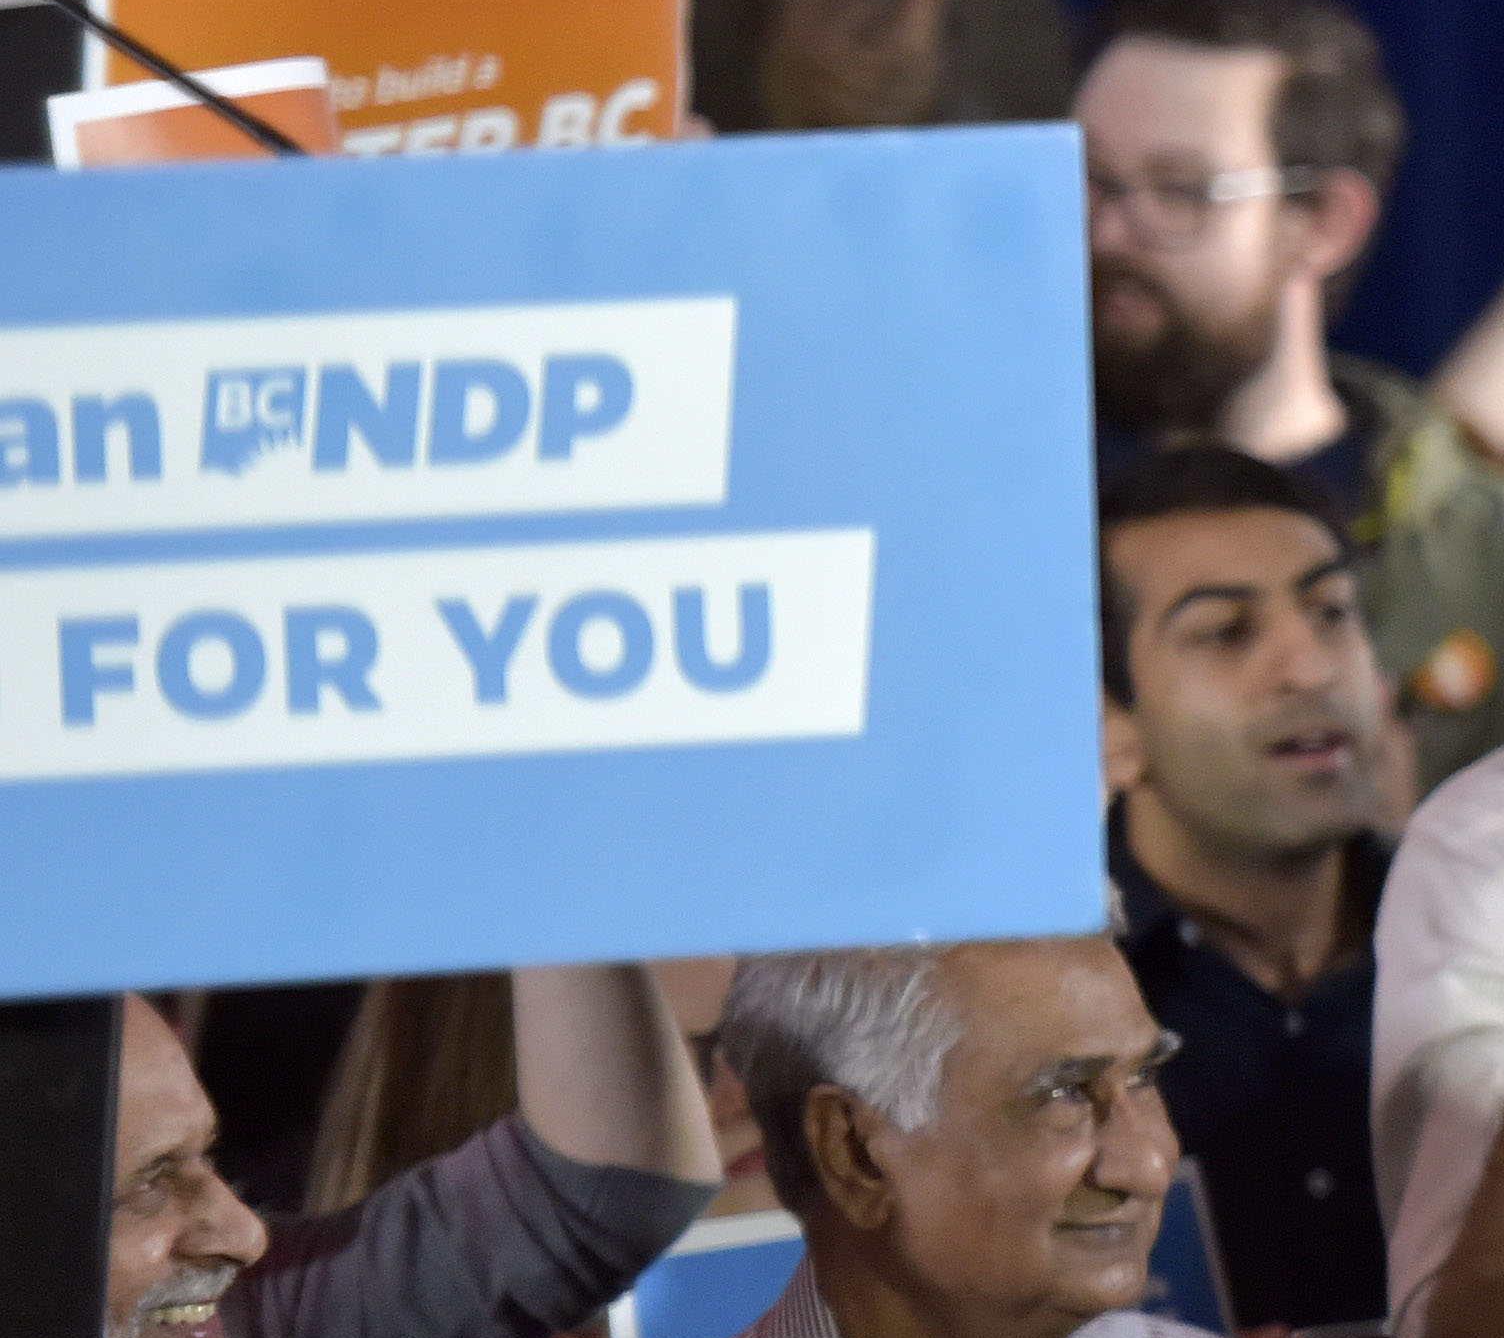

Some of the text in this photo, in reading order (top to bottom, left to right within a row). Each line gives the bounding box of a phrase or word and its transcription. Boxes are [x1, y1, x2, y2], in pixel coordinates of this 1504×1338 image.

[311, 353, 635, 474] NDP
[57, 582, 773, 729] FOR YOU
